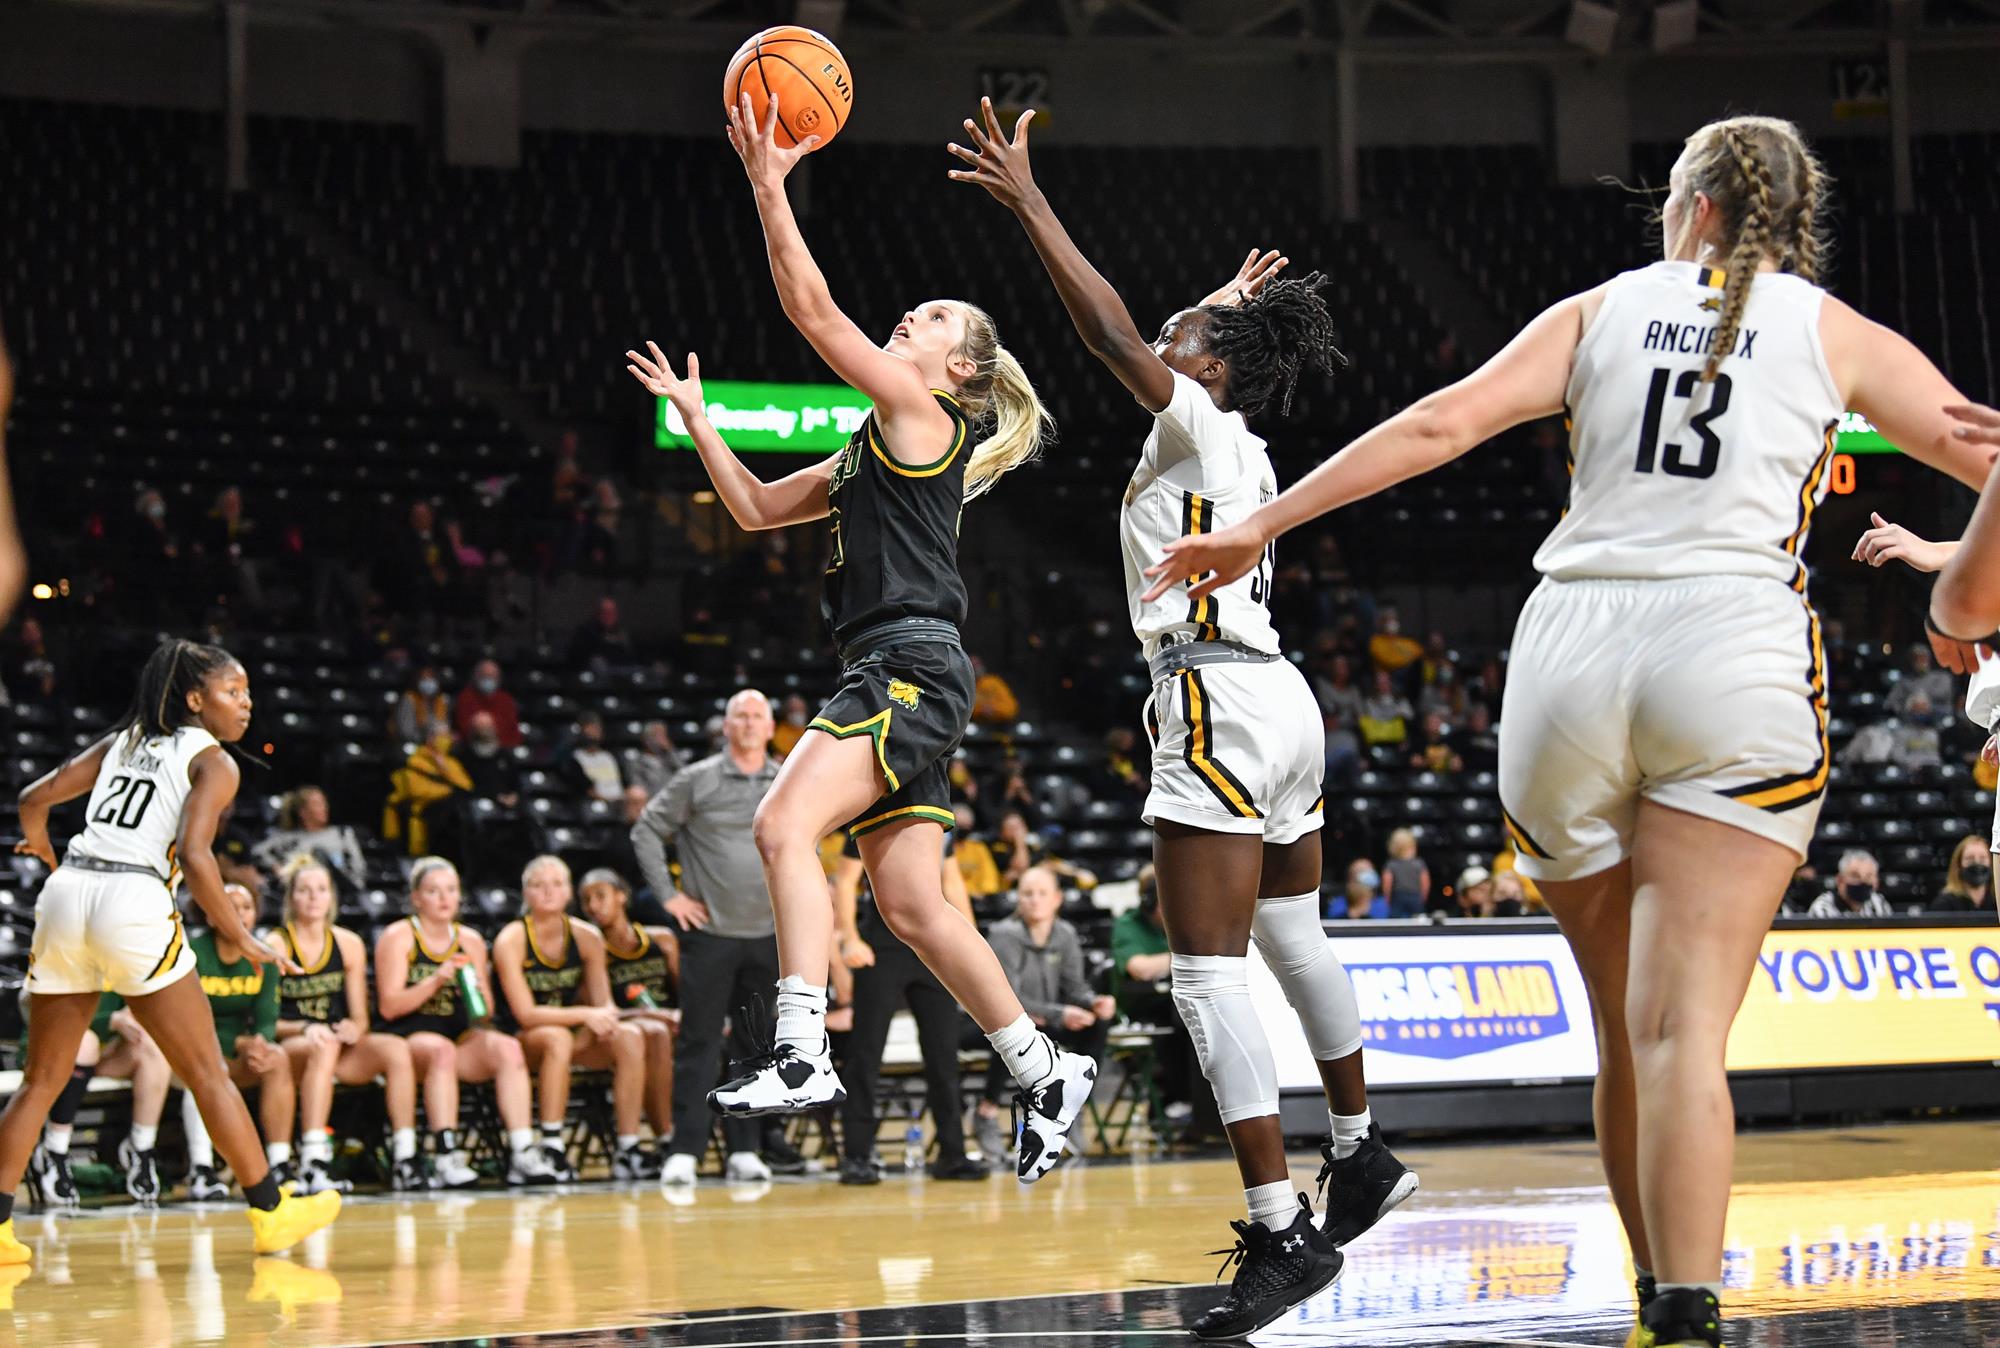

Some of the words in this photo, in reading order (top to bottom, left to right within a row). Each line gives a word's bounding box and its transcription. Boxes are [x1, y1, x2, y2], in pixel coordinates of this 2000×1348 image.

[1836, 64, 1887, 101] 12
[1634, 368, 1732, 479] 13
[92, 776, 156, 829] 20
[1348, 965, 1559, 1021] NSASLAND
[1759, 948, 1957, 993] YOU'RE
[1970, 946, 2000, 988] O
